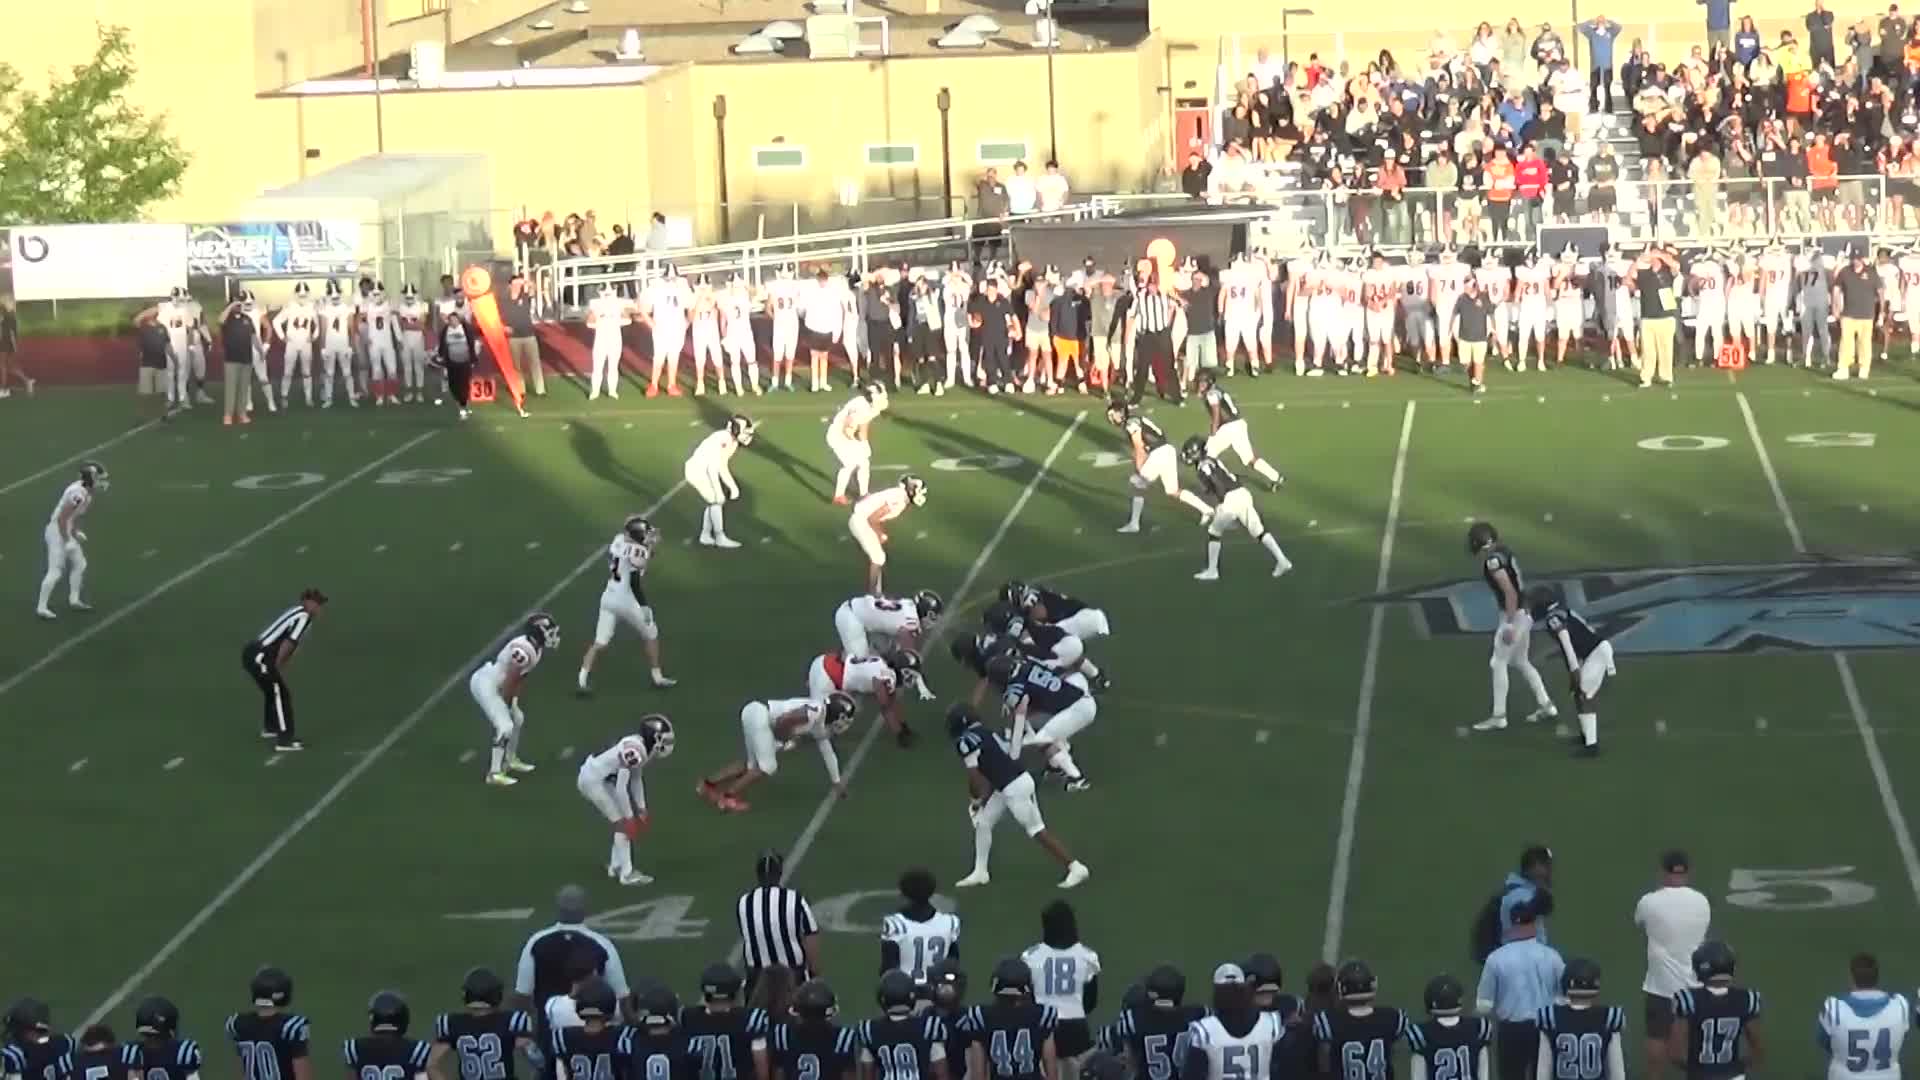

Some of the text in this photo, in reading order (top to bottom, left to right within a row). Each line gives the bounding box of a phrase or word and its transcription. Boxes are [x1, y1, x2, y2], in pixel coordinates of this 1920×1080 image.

[472, 380, 493, 398] 30
[1042, 956, 1076, 996] 18
[237, 1040, 281, 1080] 70
[456, 1032, 506, 1080] 62
[697, 1033, 738, 1080] 71
[878, 1042, 921, 1080] 18
[989, 1028, 1034, 1077] 44
[1341, 1039, 1387, 1080] 64
[1555, 1032, 1602, 1080] 20
[1699, 1017, 1741, 1064] 17
[1846, 1027, 1892, 1073] 54
[1222, 1044, 1269, 1080] 51
[1434, 1045, 1471, 1080] 21
